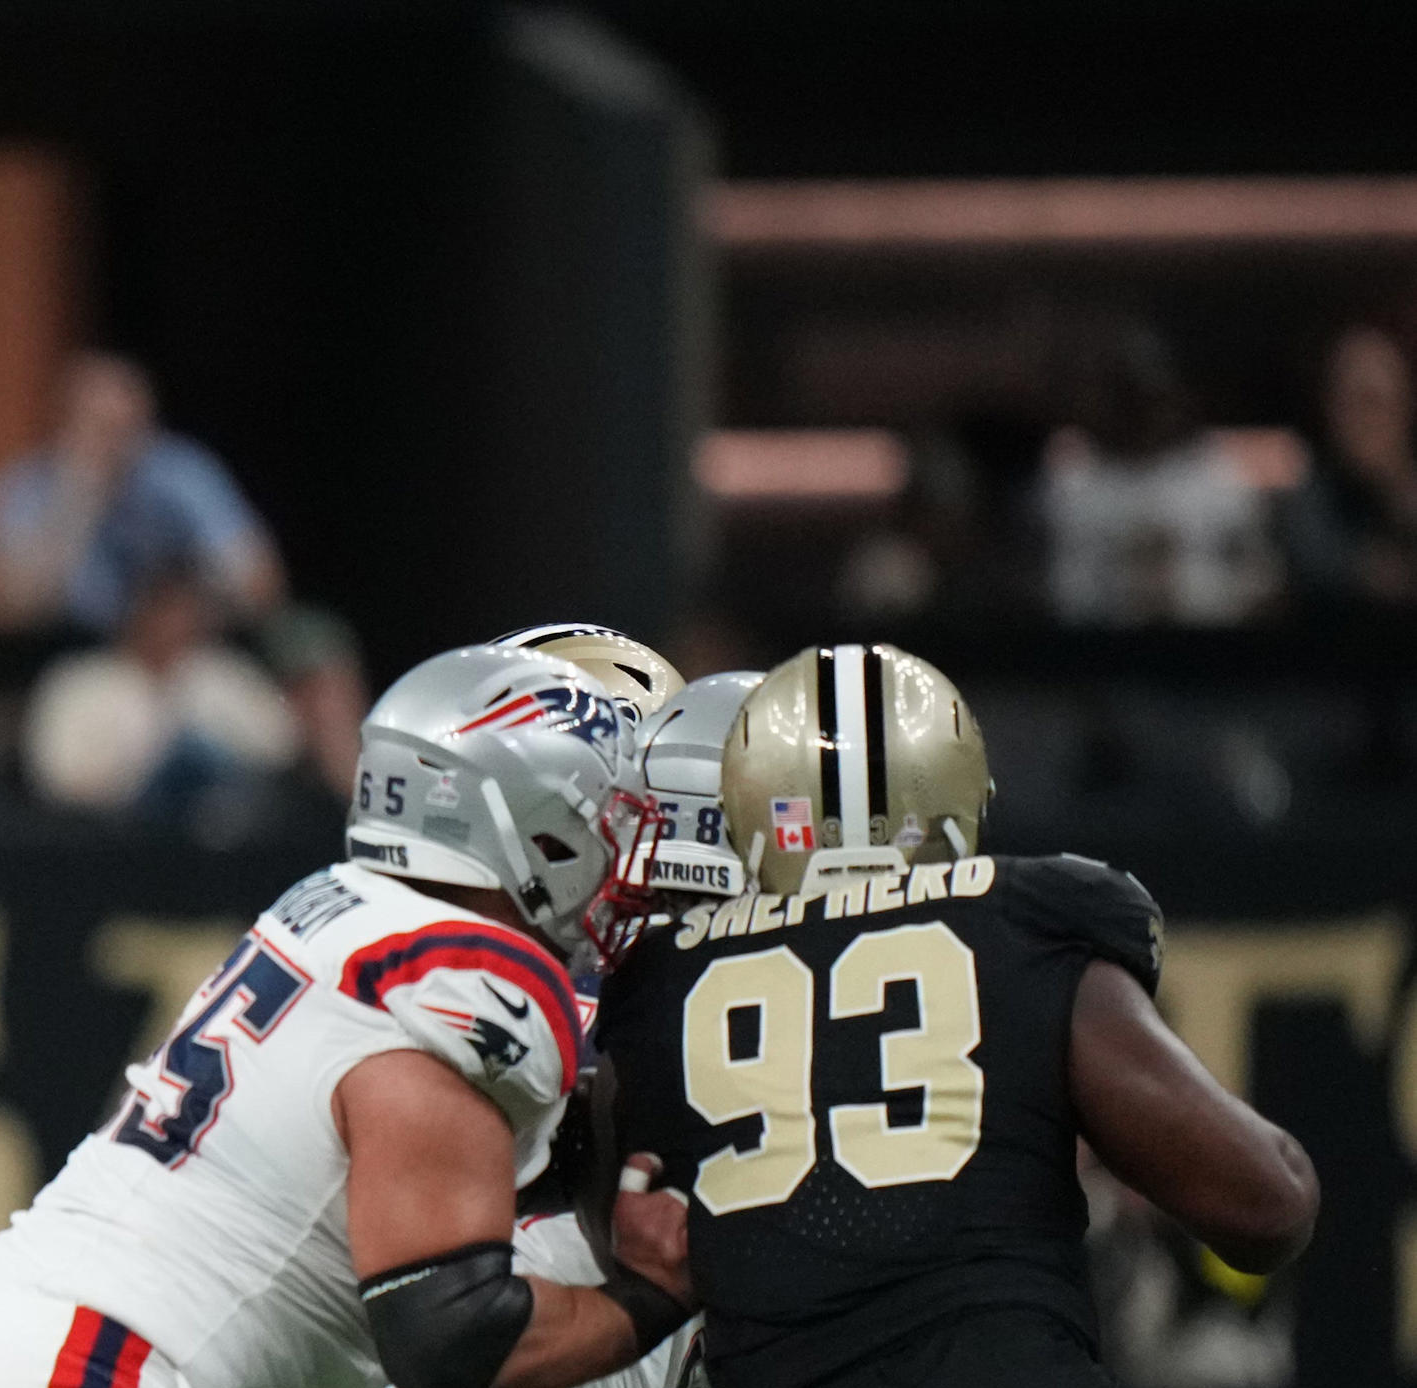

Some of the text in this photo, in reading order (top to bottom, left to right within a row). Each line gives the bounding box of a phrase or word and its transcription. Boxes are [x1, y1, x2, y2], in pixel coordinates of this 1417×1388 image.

[358, 771, 407, 816] 65
[643, 857, 730, 890] ATRIOTS
[111, 927, 314, 1172] 5
[682, 921, 985, 1217] 93
